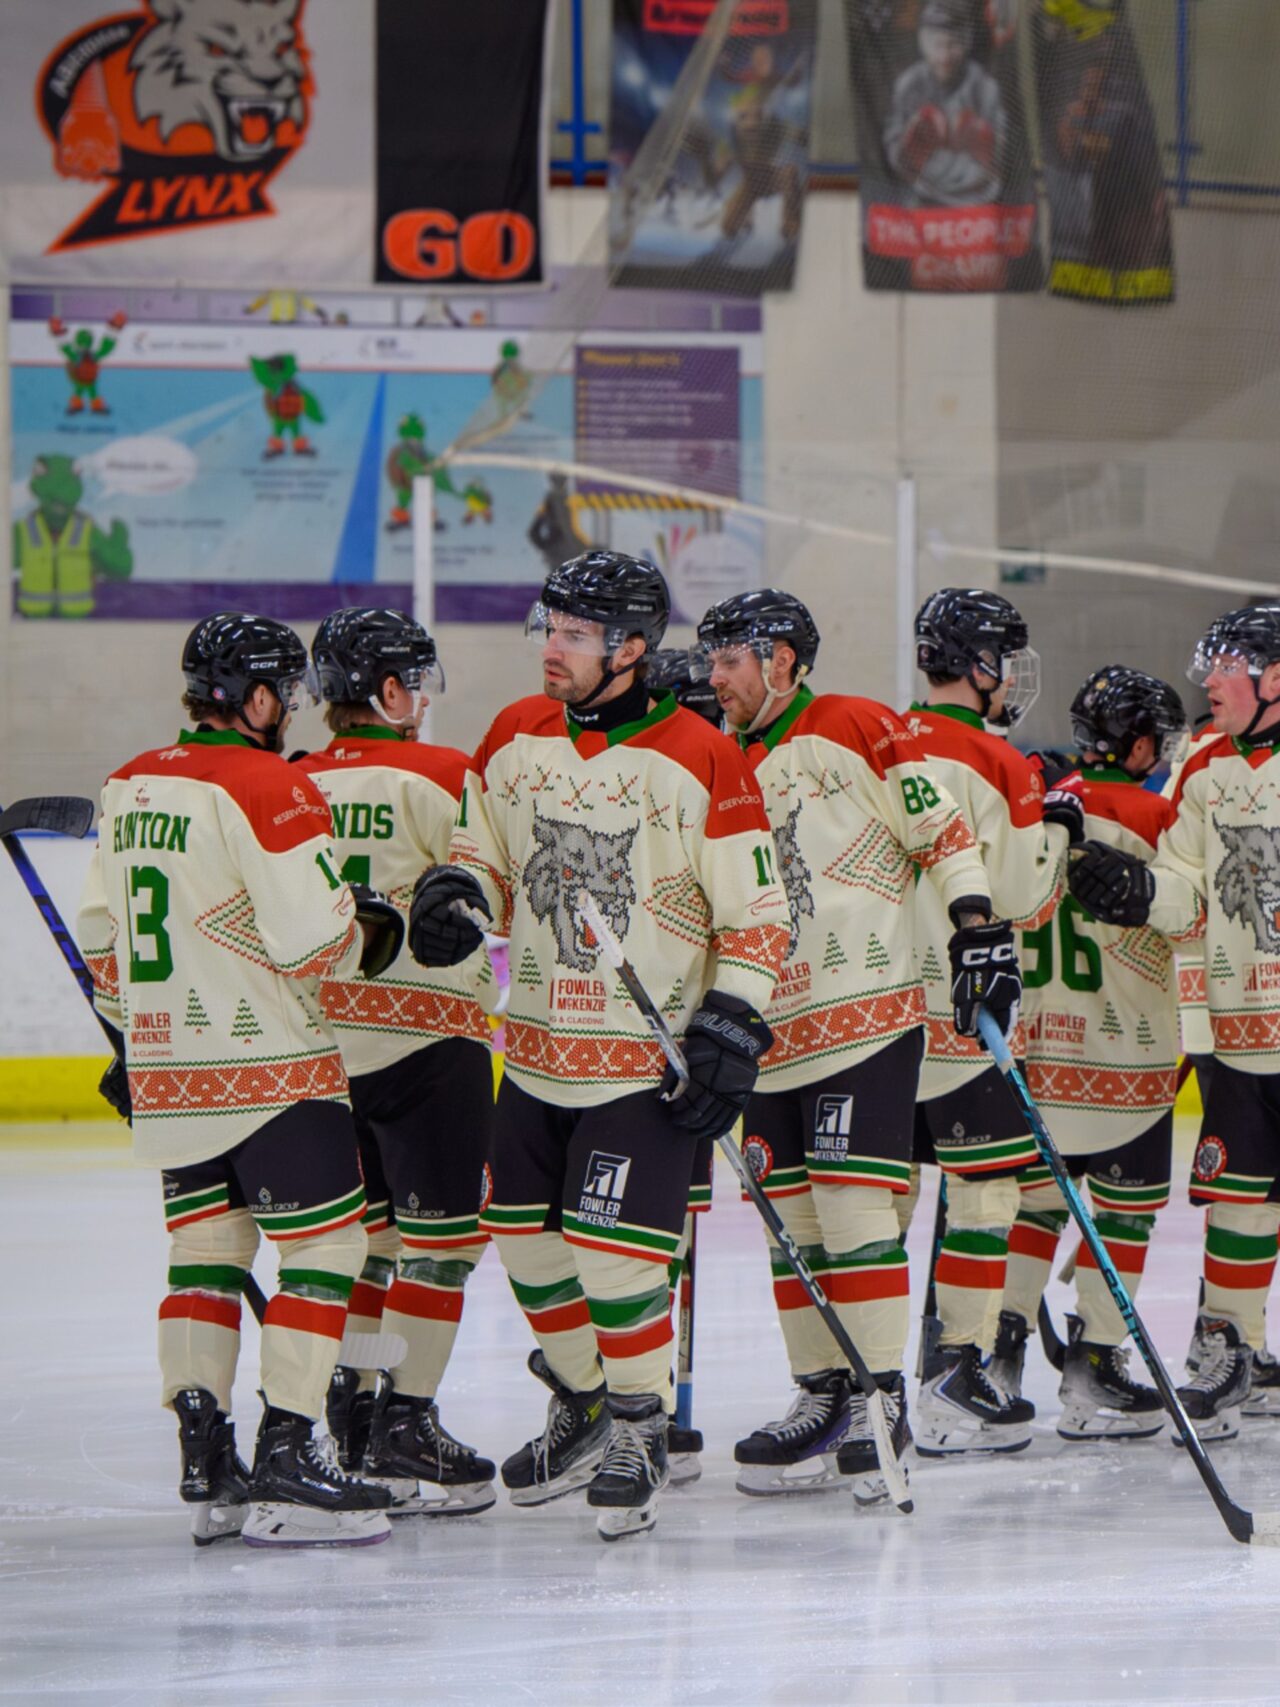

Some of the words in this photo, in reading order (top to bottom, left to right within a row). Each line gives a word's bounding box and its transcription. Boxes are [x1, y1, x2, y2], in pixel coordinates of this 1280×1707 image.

[117, 172, 264, 223] LYNX
[383, 208, 535, 280] GO
[251, 660, 279, 669] CCM
[114, 812, 191, 853] HNTON
[125, 865, 174, 983] 3
[962, 943, 1017, 967] CC
[558, 979, 607, 997] FOWLER
[134, 1012, 172, 1029] OWLER
[1046, 1012, 1087, 1031] FOWLER
[692, 1011, 761, 1056] AUER
[815, 1136, 849, 1150] FOWLER
[580, 1196, 622, 1217] FOWLER
